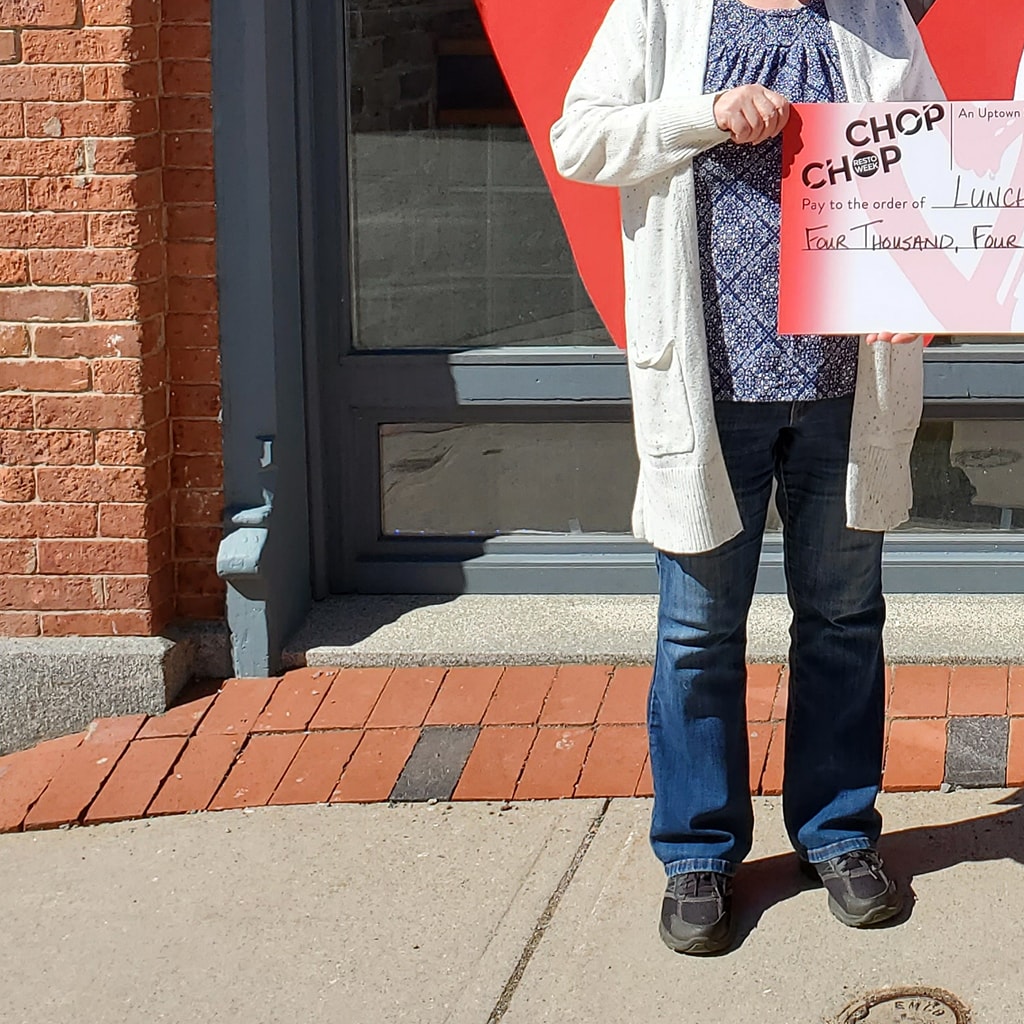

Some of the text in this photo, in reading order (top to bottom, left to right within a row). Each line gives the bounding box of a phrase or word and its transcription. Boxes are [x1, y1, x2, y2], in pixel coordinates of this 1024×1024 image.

[958, 108, 974, 119] An
[978, 108, 1021, 122] Uptown
[845, 103, 945, 147] CHOP
[853, 155, 878, 167] RESTO
[854, 163, 879, 174] WEEK
[802, 196, 926, 215] Pay to the order of
